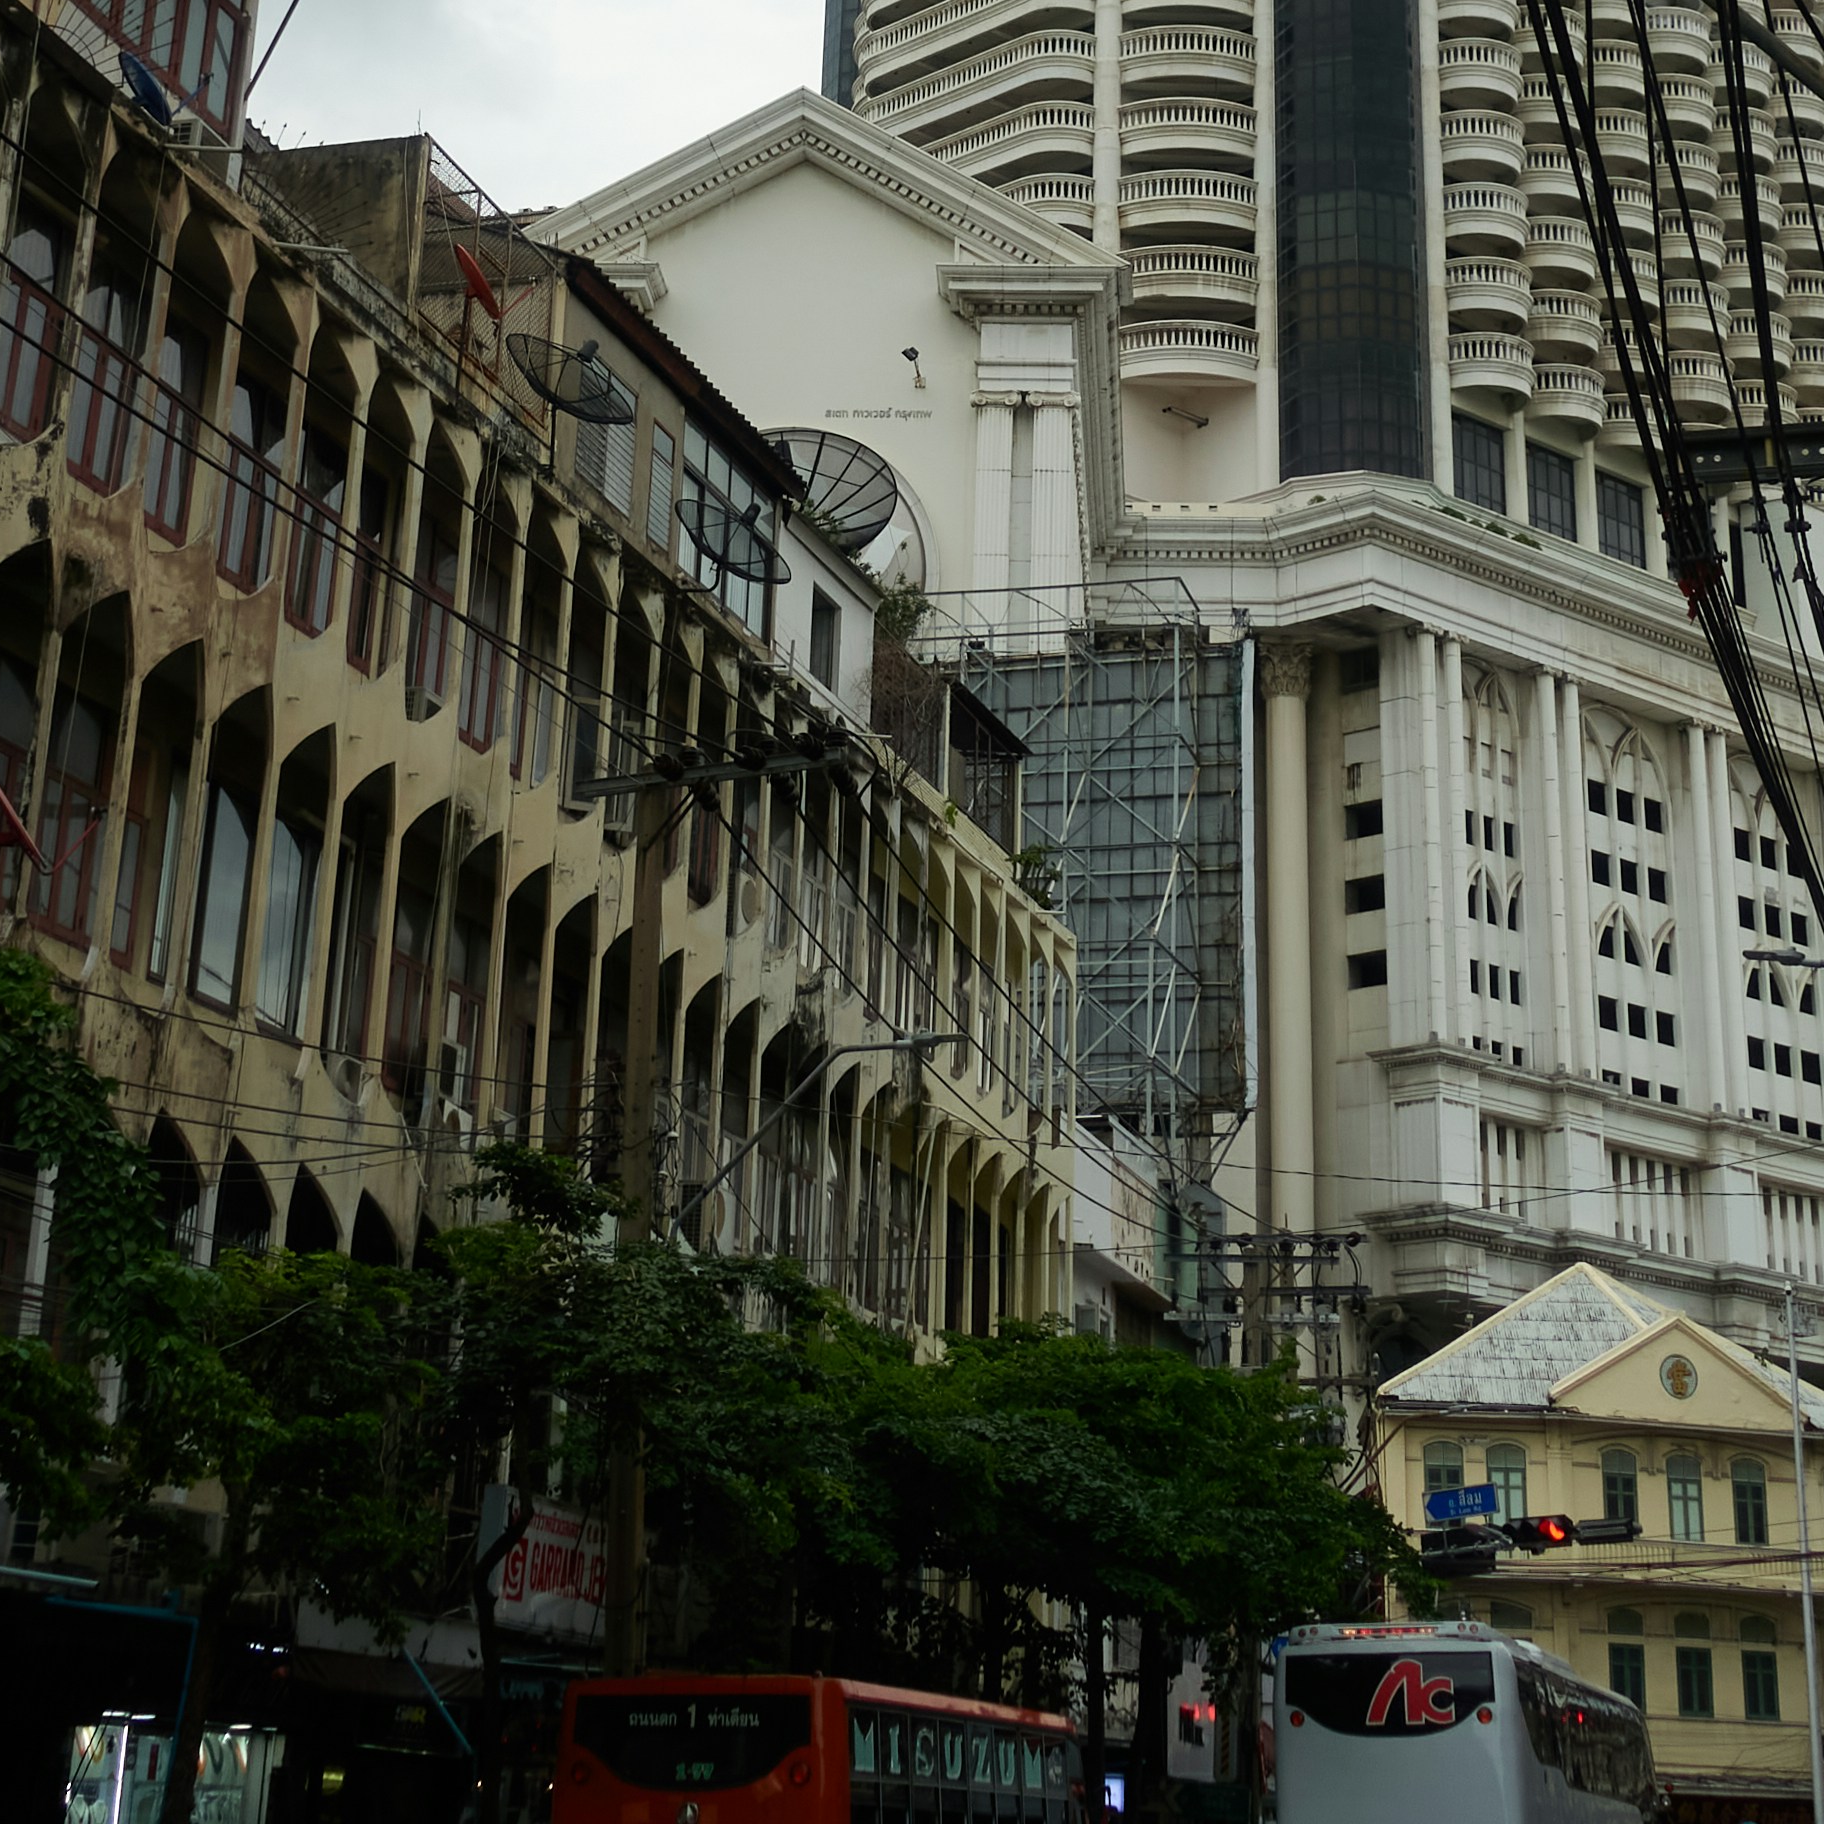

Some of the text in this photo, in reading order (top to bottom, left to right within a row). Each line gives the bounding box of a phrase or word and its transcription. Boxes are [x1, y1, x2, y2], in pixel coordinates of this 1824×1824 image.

[629, 1702, 761, 1728] ถนนตก 1 ท่าเตียน
